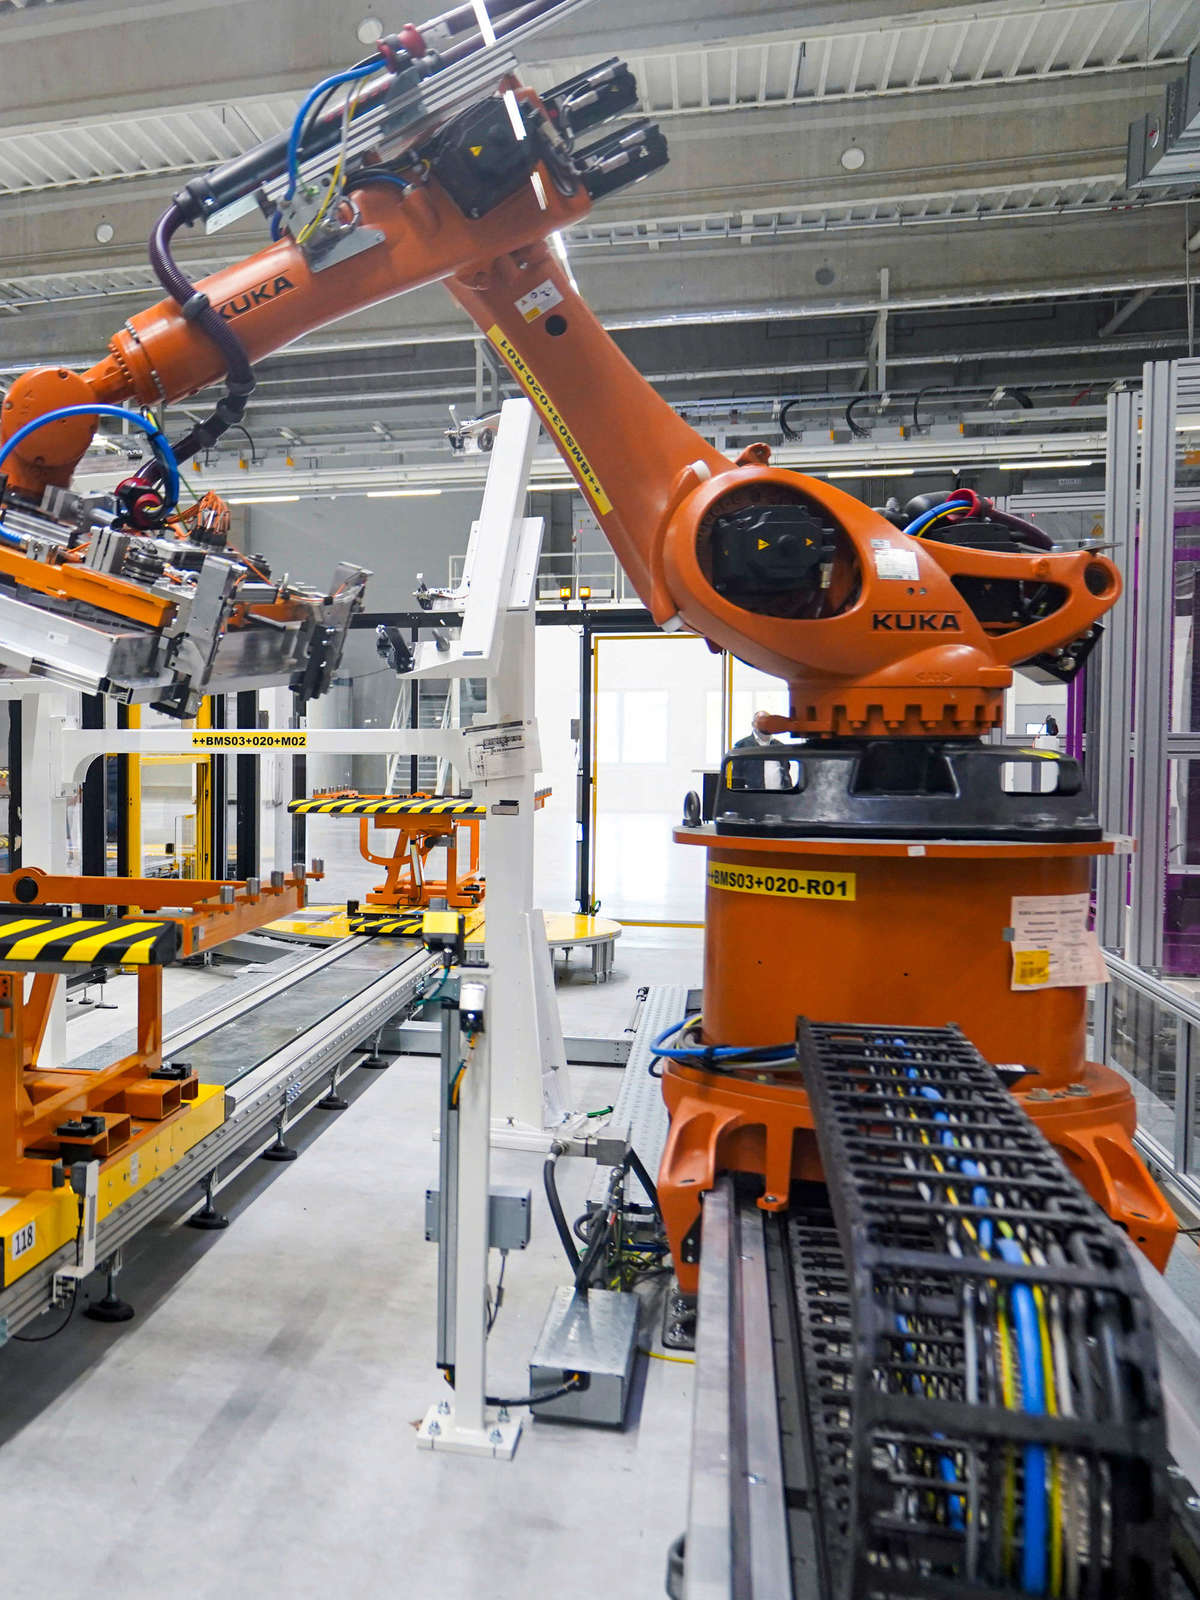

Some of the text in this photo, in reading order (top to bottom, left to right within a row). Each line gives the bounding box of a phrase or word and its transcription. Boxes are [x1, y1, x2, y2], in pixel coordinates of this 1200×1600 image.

[872, 614, 961, 630] KUKA
[192, 735, 306, 746] ++BMS03+020+M02
[15, 1225, 33, 1255] 118
